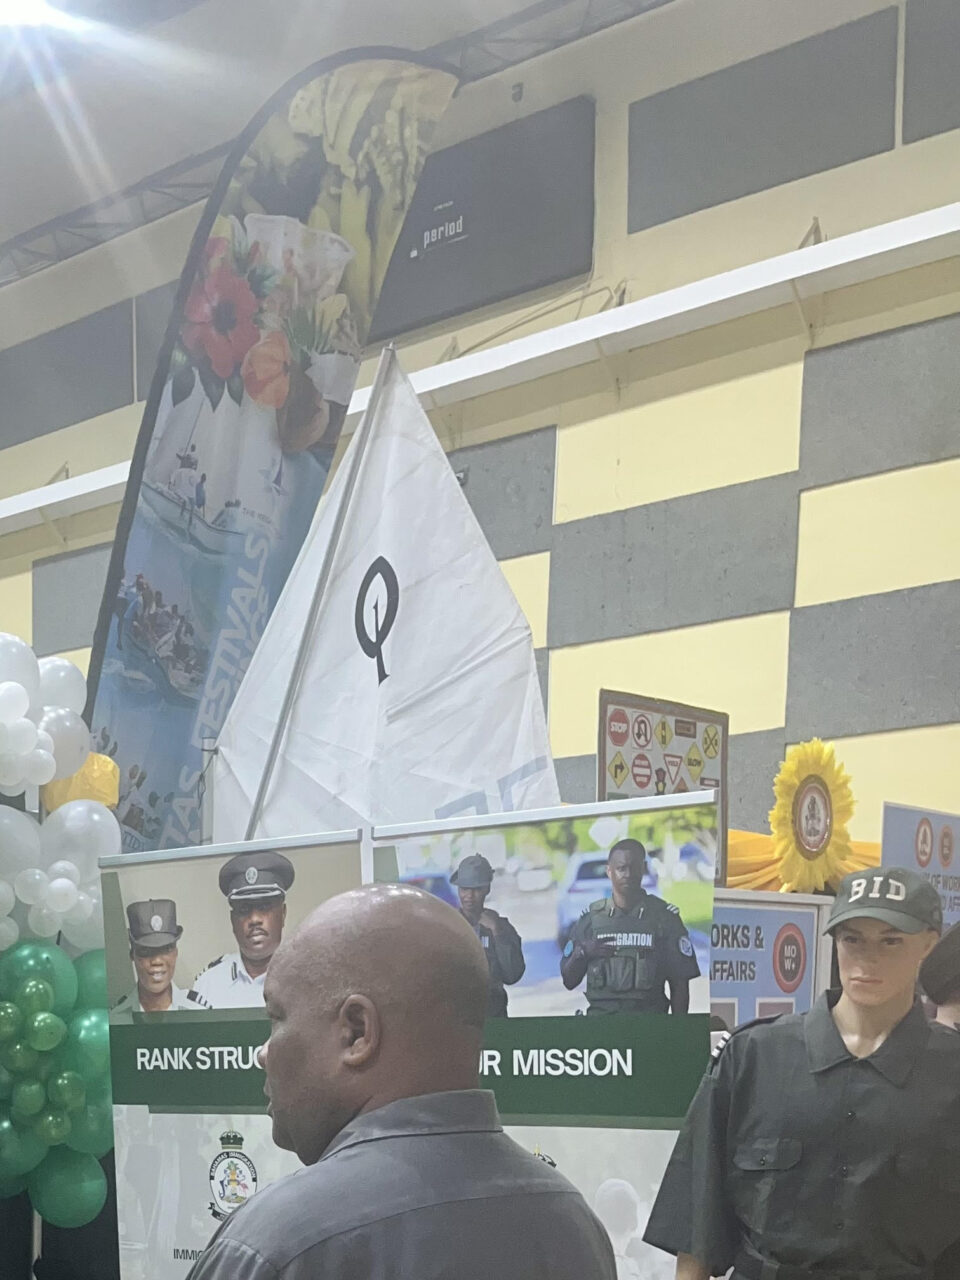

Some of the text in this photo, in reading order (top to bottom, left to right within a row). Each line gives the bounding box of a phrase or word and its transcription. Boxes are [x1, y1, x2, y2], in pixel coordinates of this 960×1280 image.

[355, 555, 400, 687] Q
[848, 876, 907, 903] BID
[711, 923, 765, 949] ORKS &
[136, 1046, 264, 1070] RANK STRUC
[512, 1048, 633, 1076] MISSION
